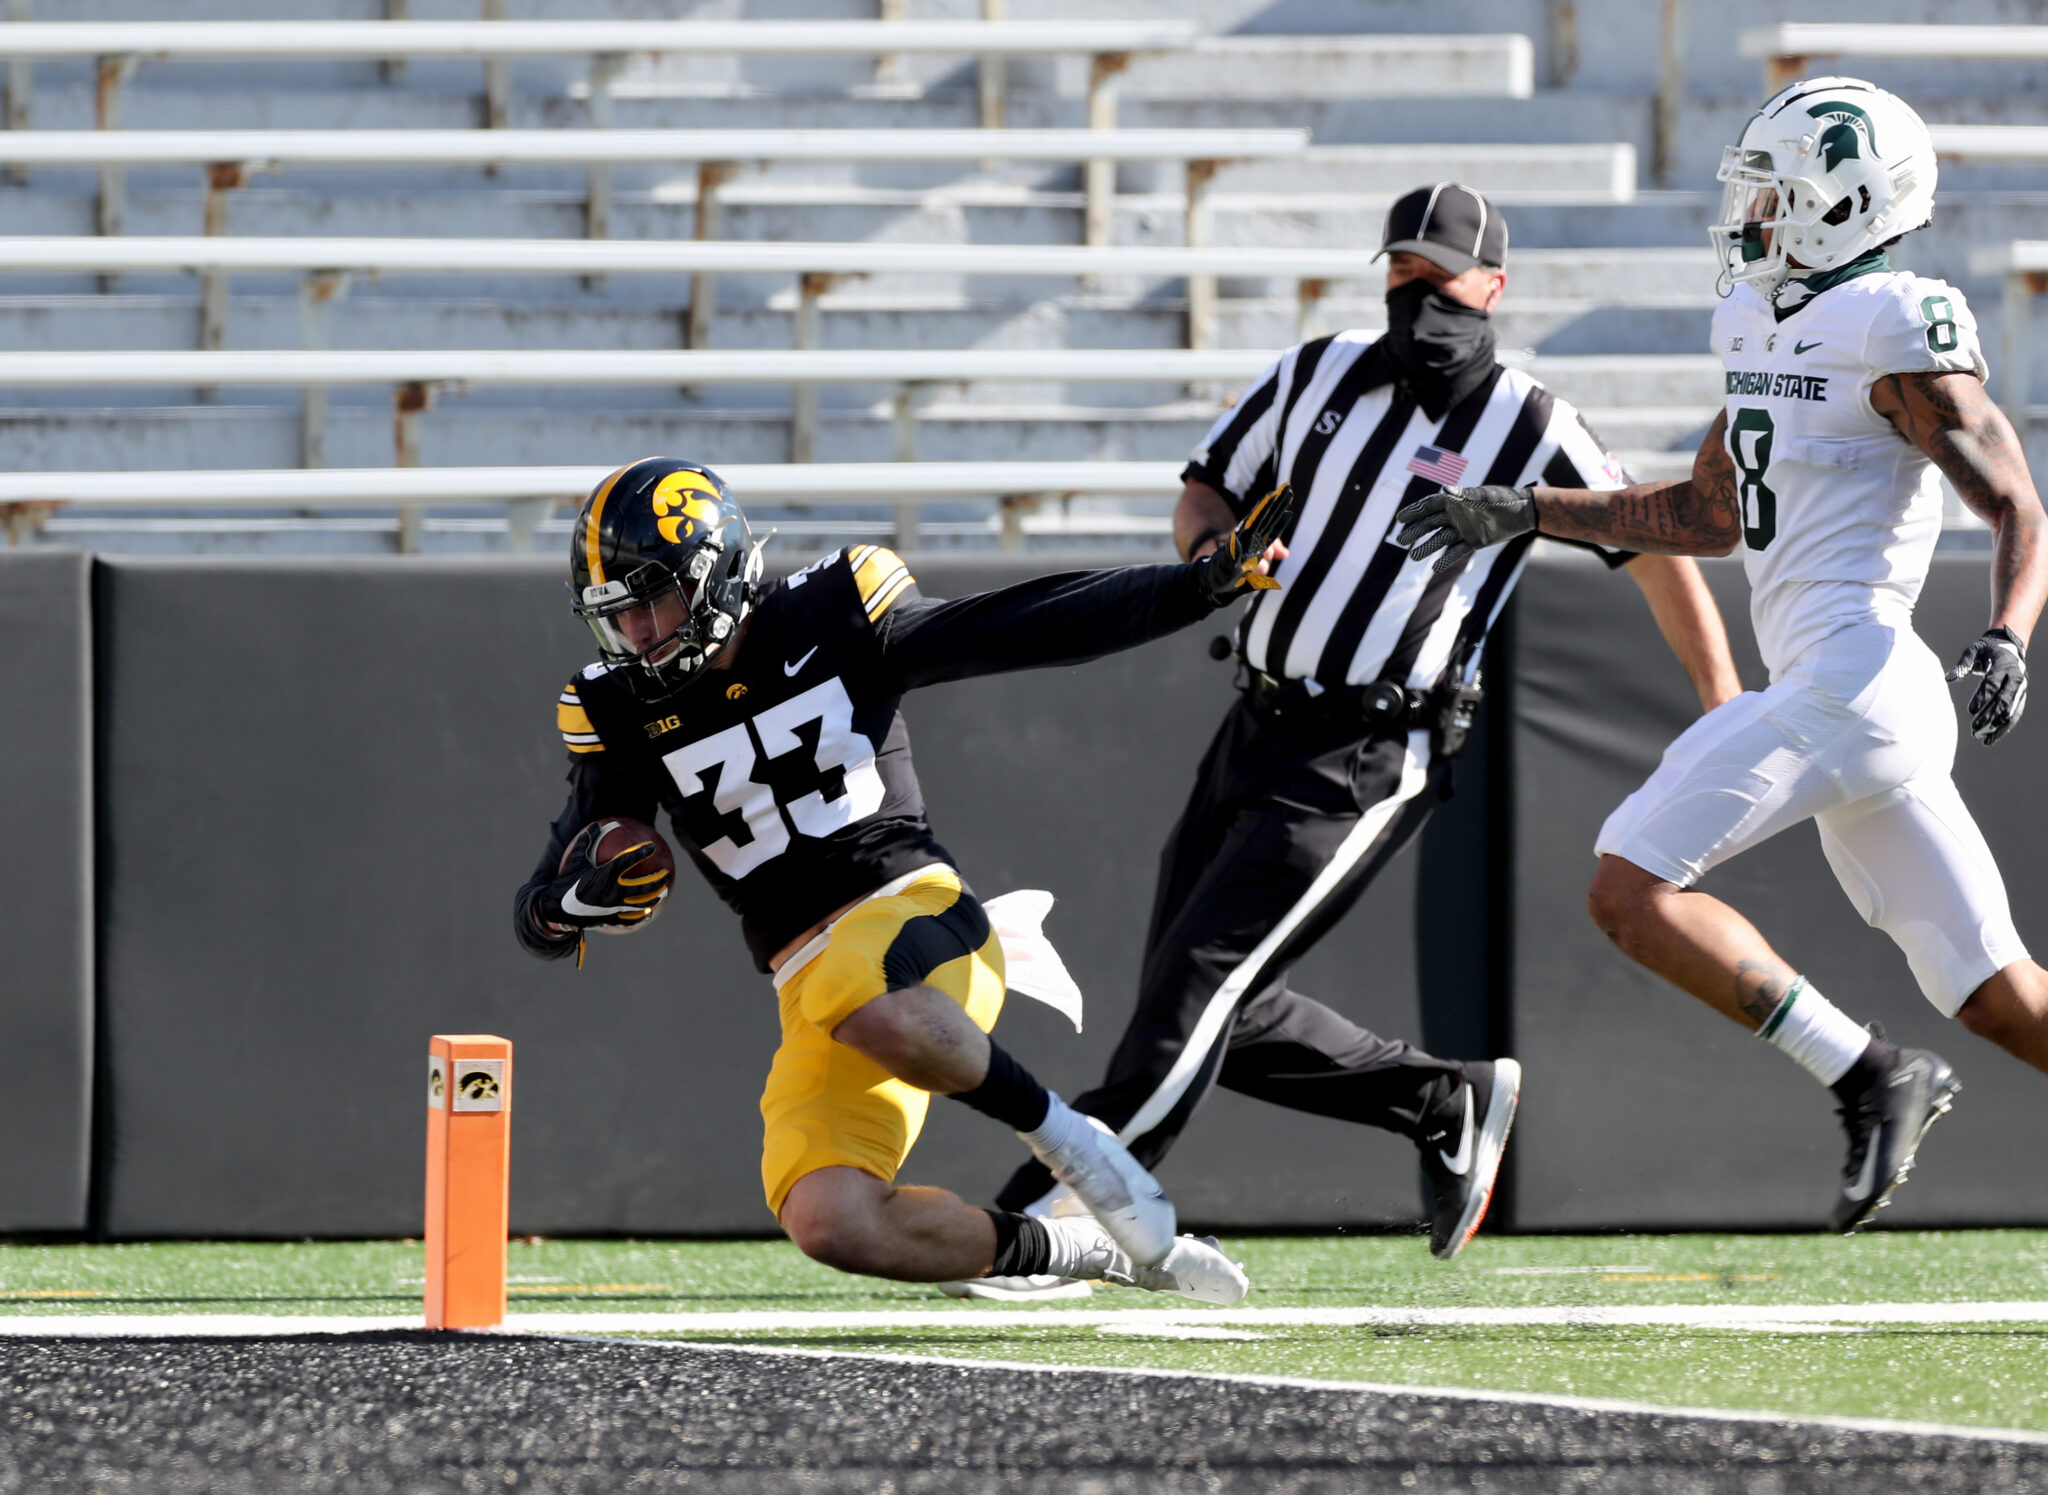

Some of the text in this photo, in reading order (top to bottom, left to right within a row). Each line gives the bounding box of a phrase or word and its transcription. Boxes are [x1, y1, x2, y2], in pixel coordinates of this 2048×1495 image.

[1919, 294, 1959, 353] 8
[1773, 374, 1829, 402] STATE
[1730, 408, 1777, 551] 8
[589, 585, 610, 598] IOWA
[661, 675, 886, 880] 33
